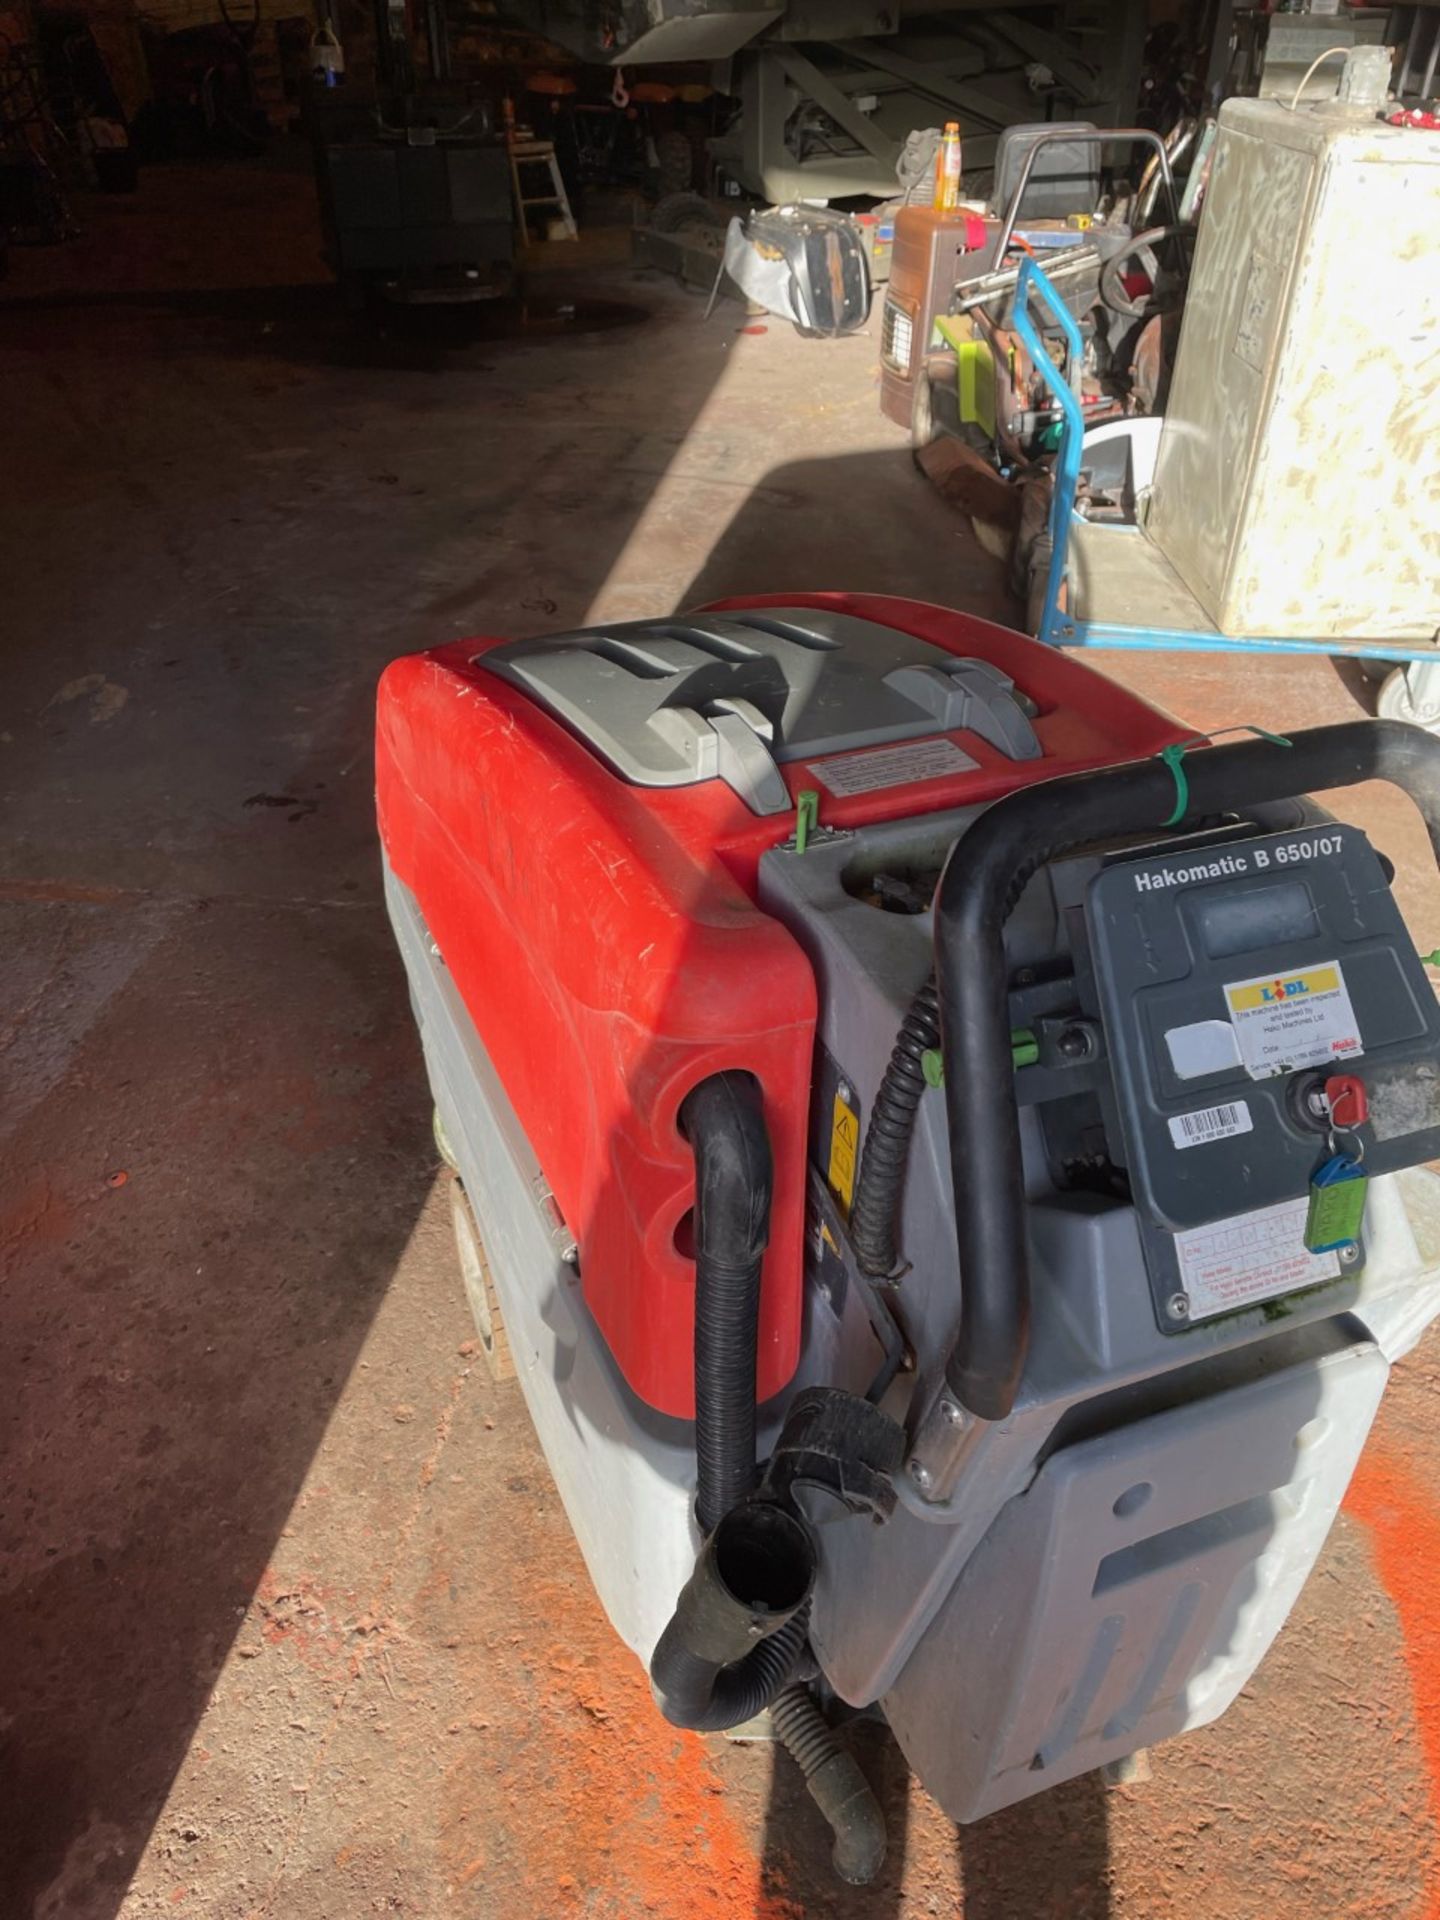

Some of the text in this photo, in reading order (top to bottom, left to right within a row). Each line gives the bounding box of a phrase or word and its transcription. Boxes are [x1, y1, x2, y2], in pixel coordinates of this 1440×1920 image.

[1134, 836, 1343, 892] Hakomatic B 650/07
[1236, 1010, 1250, 1018] This
[1251, 1005, 1279, 1016] machine
[1263, 1013, 1325, 1033] Hako Machines Ltd
